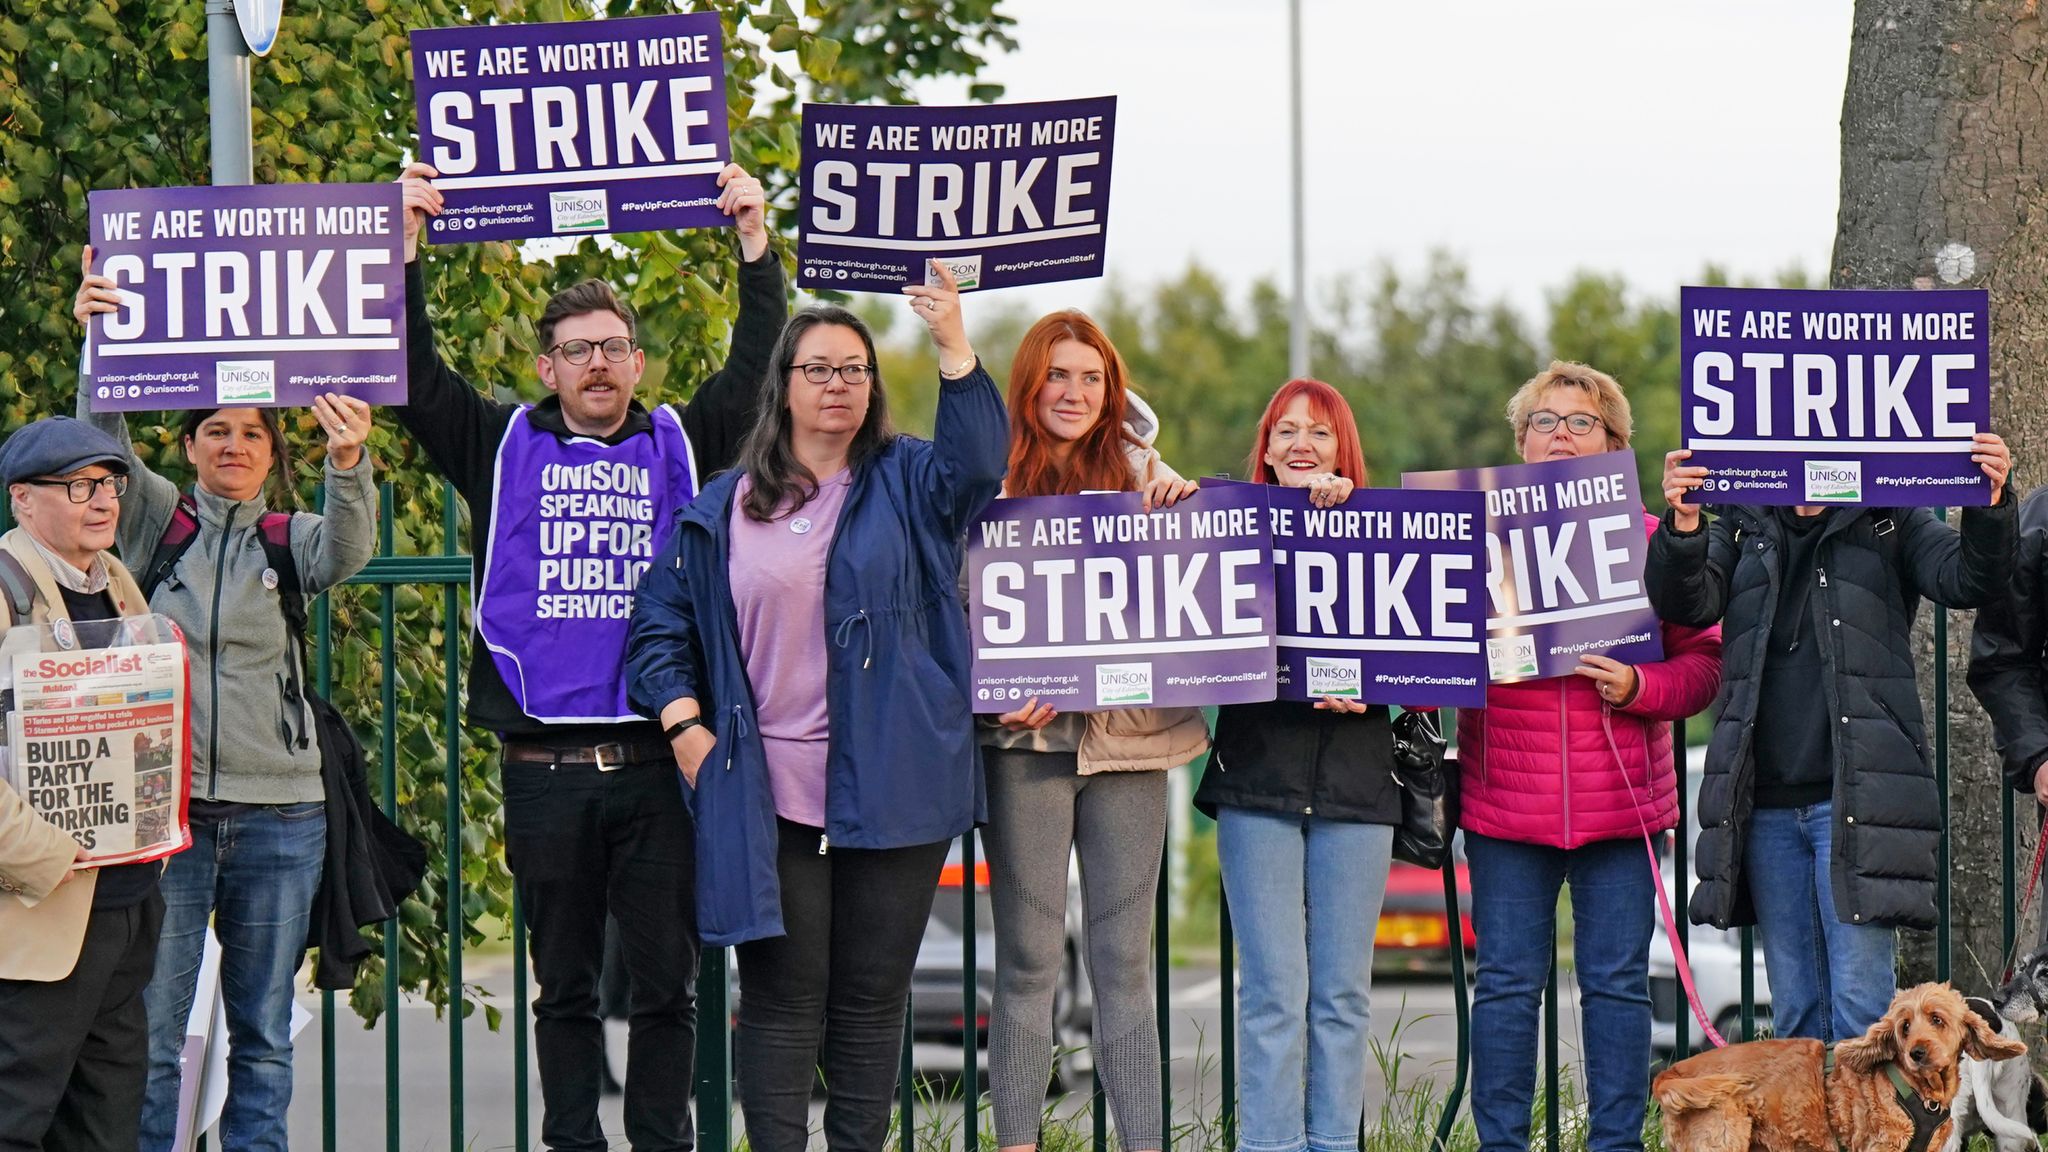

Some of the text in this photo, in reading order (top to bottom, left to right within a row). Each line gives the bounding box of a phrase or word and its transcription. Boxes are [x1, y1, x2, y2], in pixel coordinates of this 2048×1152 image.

[425, 35, 710, 78] WE ARE WORTH MORE
[430, 76, 717, 174] STRIKE
[815, 116, 1102, 150] WE ARE WORTH MORE
[812, 152, 1100, 237] STRIKE
[438, 202, 533, 216] nison-edinburgh.org.uk
[555, 200, 602, 212] UNISON
[621, 197, 720, 212] #PayUpForCouncilSta
[103, 206, 390, 241] WE ARE WORTH MORE
[479, 215, 534, 227] @unisonedin
[804, 258, 908, 272] unison-edinburgh.org.uk
[931, 264, 976, 276] USON
[994, 254, 1095, 272] #PayUpForCouncilStaff
[851, 272, 907, 282] @unisonedin
[103, 249, 391, 339] STRIKE
[1693, 309, 1974, 340] WE ARE WORTH MORE
[97, 372, 199, 383] unison-edinburgh.org.uk
[222, 371, 269, 382] UNISON
[289, 375, 397, 385] #PayUpForCouncilStaff
[143, 384, 199, 393] @unisonedin
[1693, 351, 1976, 437] STRIKE
[542, 460, 649, 495] UNISON
[1810, 470, 1856, 481] UNISON
[1876, 476, 1981, 486] #PayUpForCouncilStaff
[1733, 480, 1788, 490] @unisonedin
[1488, 473, 1626, 517] ORTH MORE
[540, 494, 652, 520] SPEAKING
[981, 507, 1259, 548] WE ARE WORTH MORE
[1270, 508, 1472, 540] RE WORTH MORE
[540, 521, 652, 557] UP FOR
[1486, 514, 1640, 614] RIKE
[982, 549, 1262, 644] STRIKE
[1273, 549, 1472, 638] RIKE
[1491, 645, 1531, 659] UNON
[1550, 632, 1651, 655] #PayUpForCouncilStaff
[24, 669, 37, 678] the
[39, 654, 142, 679] Socialist
[1311, 667, 1357, 679] UNISON
[977, 674, 1079, 685] unison-edinburgh.org.uk
[1101, 673, 1148, 685] UNISON
[1166, 672, 1267, 685] #PayUpForCouncilStaff
[1375, 674, 1476, 686] #PayUpForCouncilStaff
[1024, 686, 1079, 697] @unisonedin
[33, 716, 51, 725] Tories
[53, 715, 64, 723] and
[66, 714, 79, 723] SNP
[66, 724, 86, 732] Labour
[26, 737, 110, 764] BUILD A
[28, 761, 93, 787] PARTY
[29, 782, 113, 810] FOR THE
[39, 803, 129, 831] ORKING
